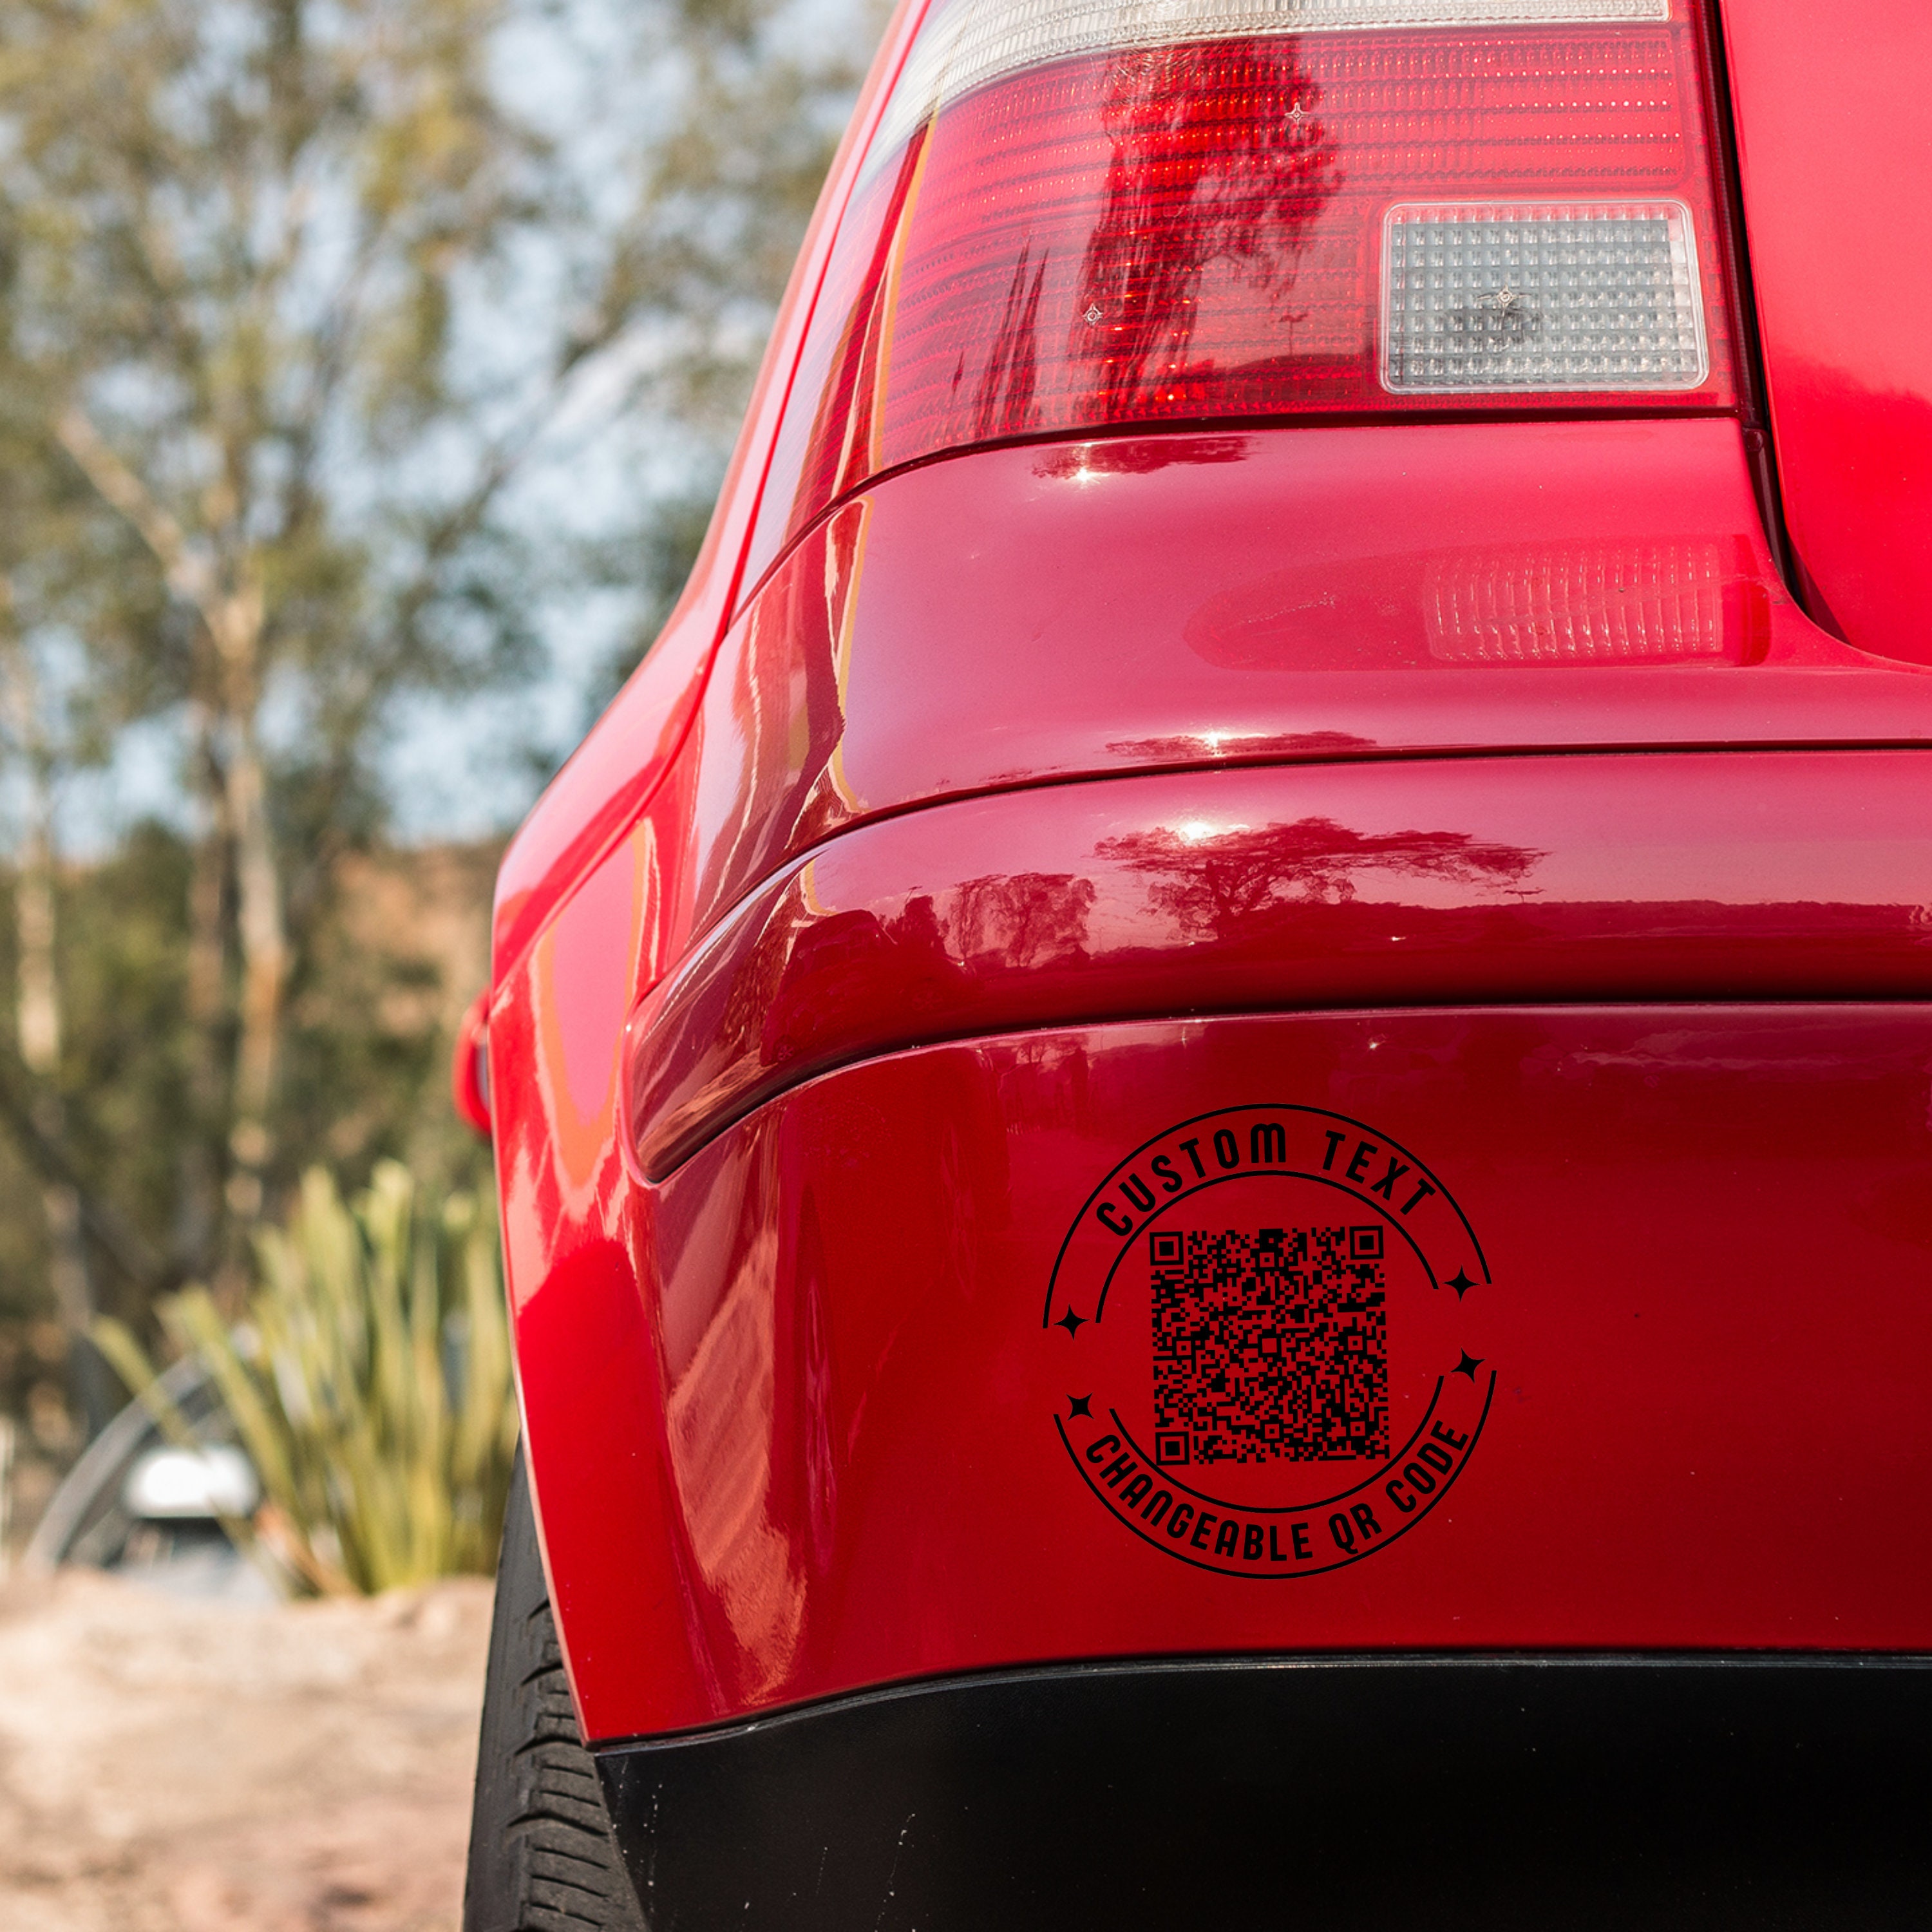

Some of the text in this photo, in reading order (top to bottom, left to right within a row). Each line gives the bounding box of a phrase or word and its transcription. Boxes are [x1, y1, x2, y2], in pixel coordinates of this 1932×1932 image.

[1096, 1122, 1436, 1236] CUSTOM TEXT
[1086, 1420, 1469, 1562] CHANGEABLE QR CODE
